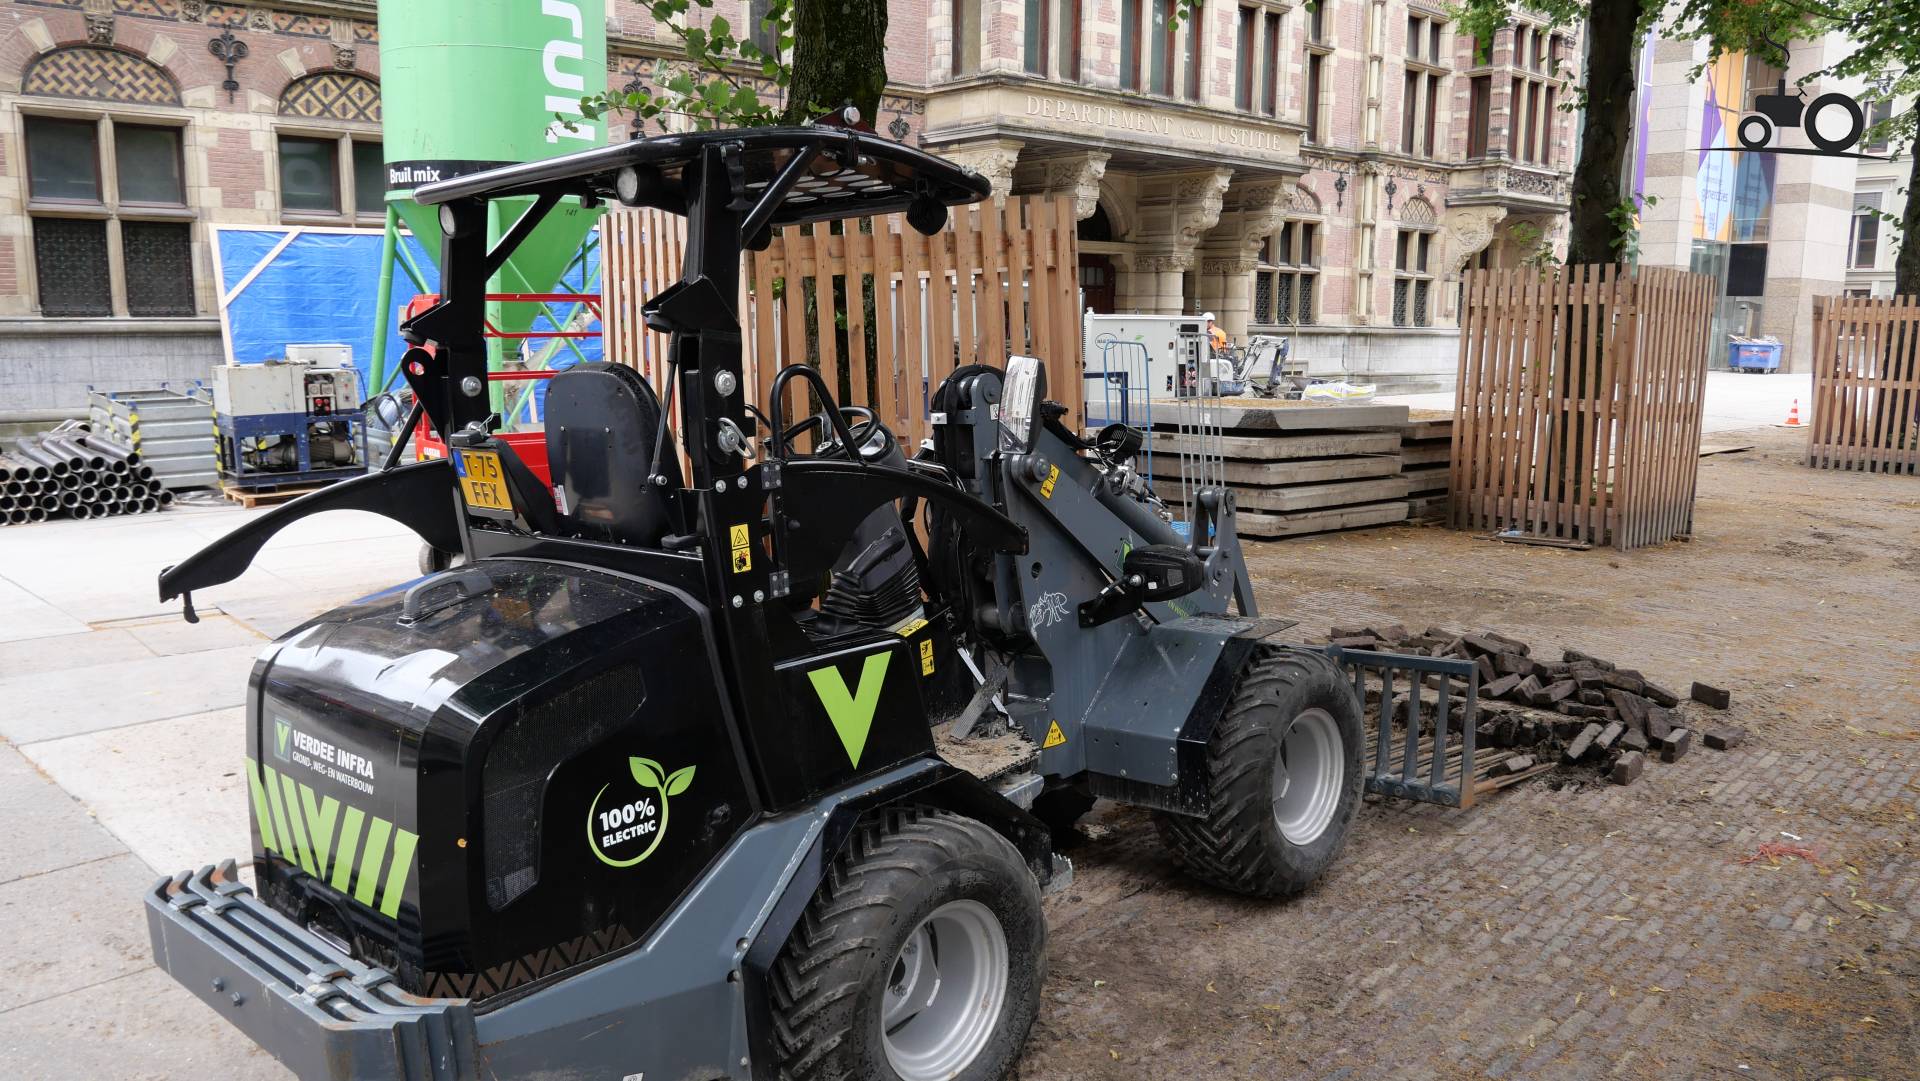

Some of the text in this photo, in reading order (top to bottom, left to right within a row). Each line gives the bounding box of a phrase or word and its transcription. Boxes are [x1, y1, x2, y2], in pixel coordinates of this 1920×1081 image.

[1025, 95, 1173, 135] DEPARTEMENT
[1209, 124, 1282, 151] JUSTITIE
[389, 167, 412, 184] Bruil
[414, 166, 440, 182] mix
[463, 454, 498, 479] T-75
[471, 481, 502, 505] FFX
[293, 730, 374, 779] VERDEE INFRA
[313, 761, 327, 775] WEG-
[327, 767, 336, 780] EN
[336, 770, 374, 795] WATERBOUW
[599, 797, 656, 832] 100%
[602, 820, 656, 848] ELECTRIC
